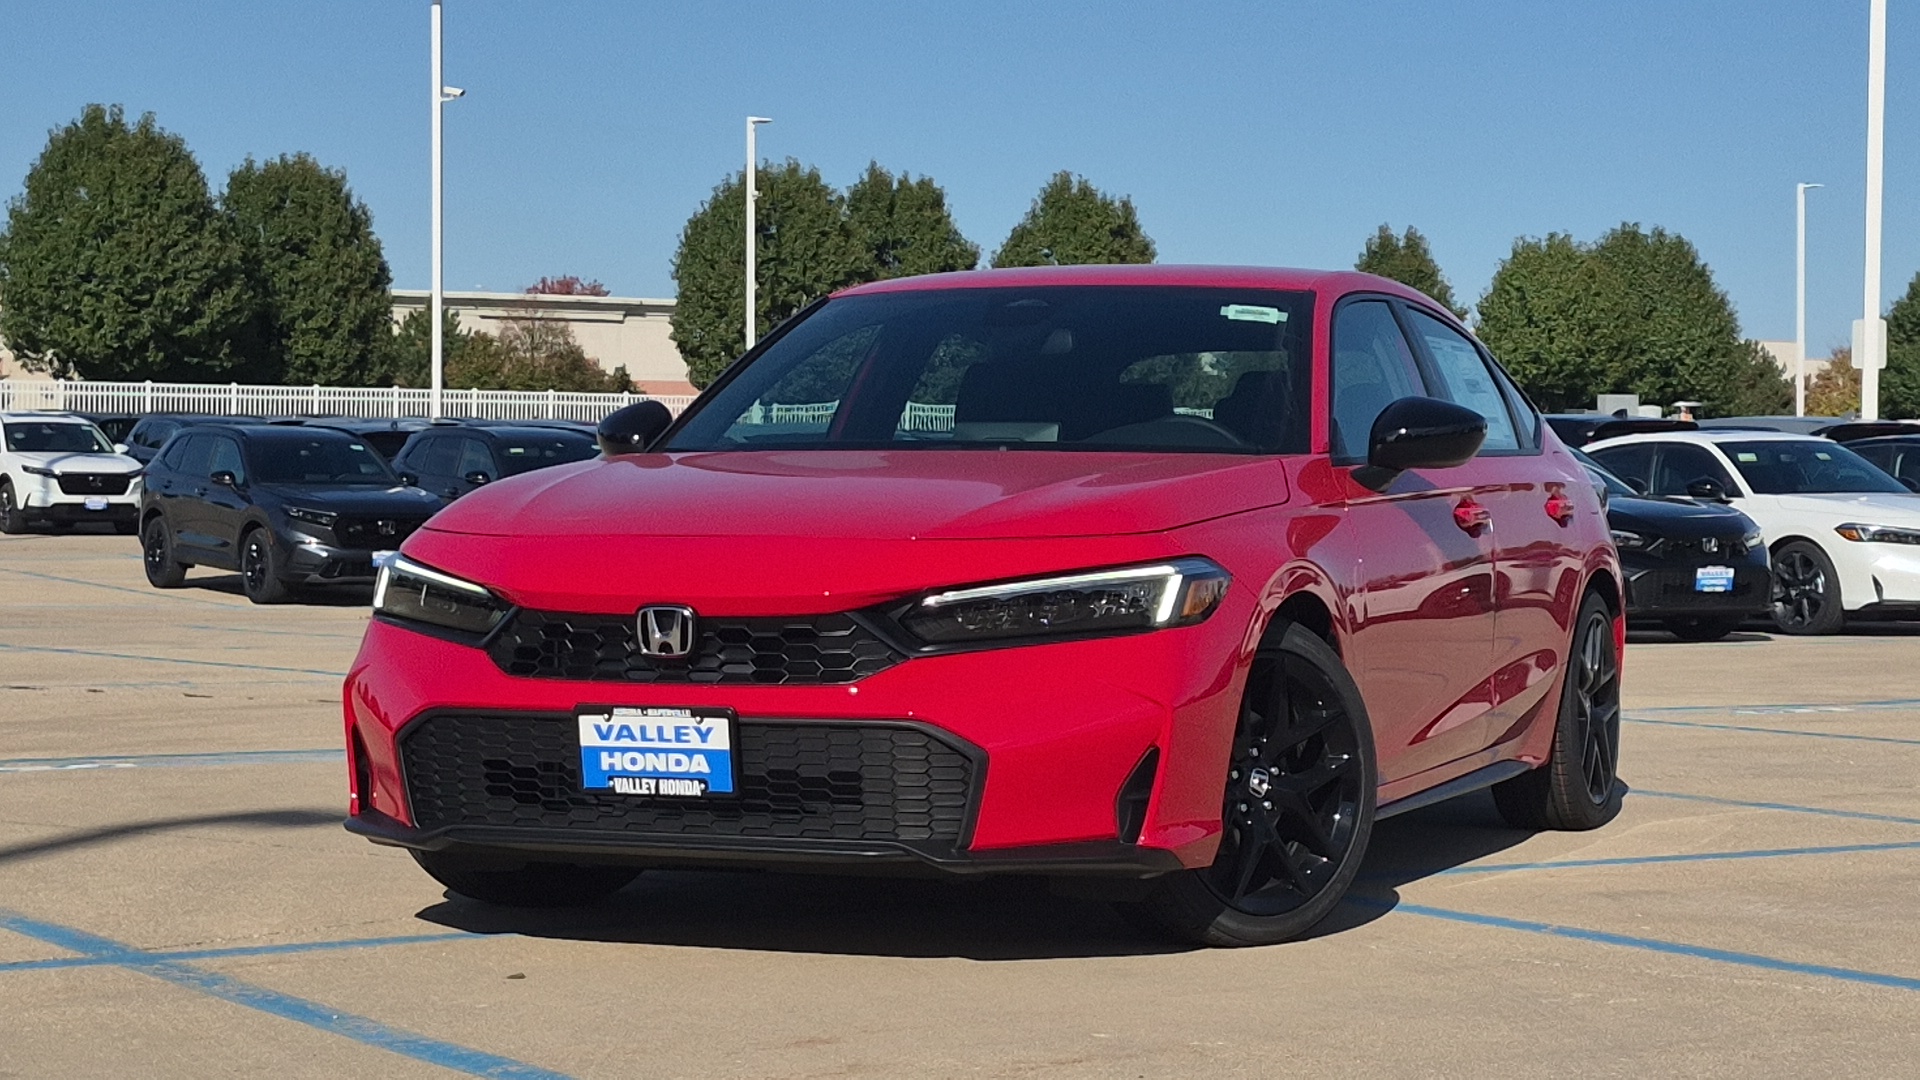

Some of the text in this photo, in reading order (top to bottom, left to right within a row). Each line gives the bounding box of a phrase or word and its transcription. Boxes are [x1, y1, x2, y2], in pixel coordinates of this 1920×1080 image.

[593, 723, 714, 744] VALLEY
[600, 751, 712, 774] HONDA
[613, 777, 702, 797] VALLEY HONDA
